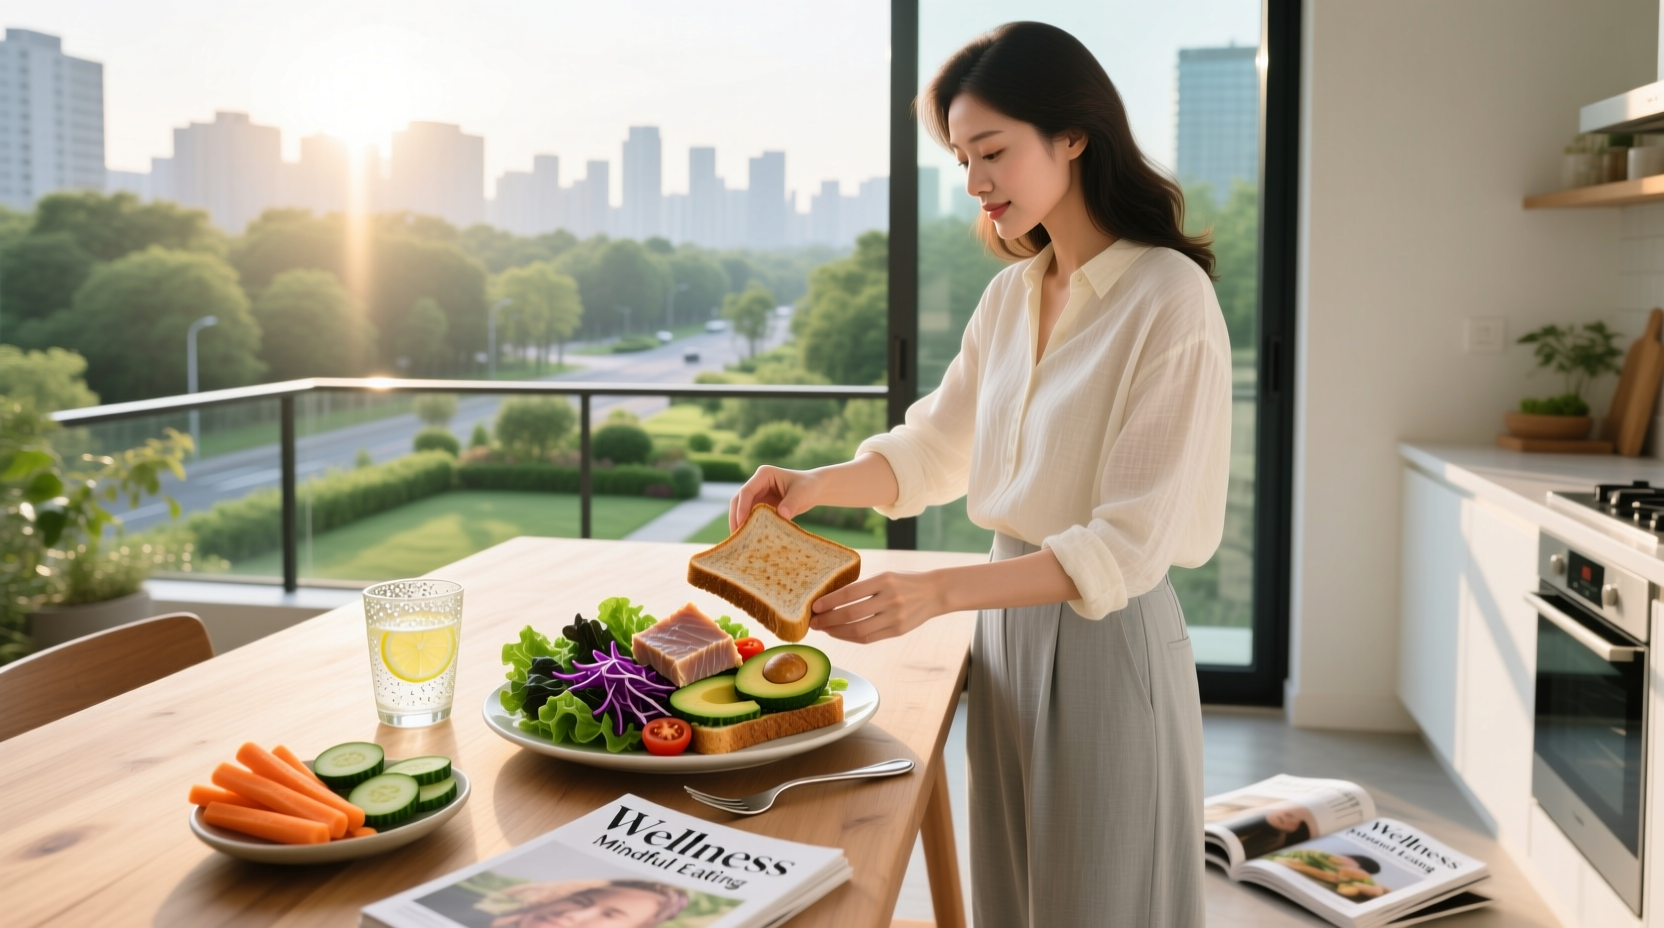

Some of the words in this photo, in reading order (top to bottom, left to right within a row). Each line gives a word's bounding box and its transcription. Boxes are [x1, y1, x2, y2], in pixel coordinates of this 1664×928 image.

[592, 833, 678, 871] Mindful
[676, 862, 748, 891] Eating
[606, 804, 796, 877] Wellness
[1371, 821, 1461, 870] Wellness
